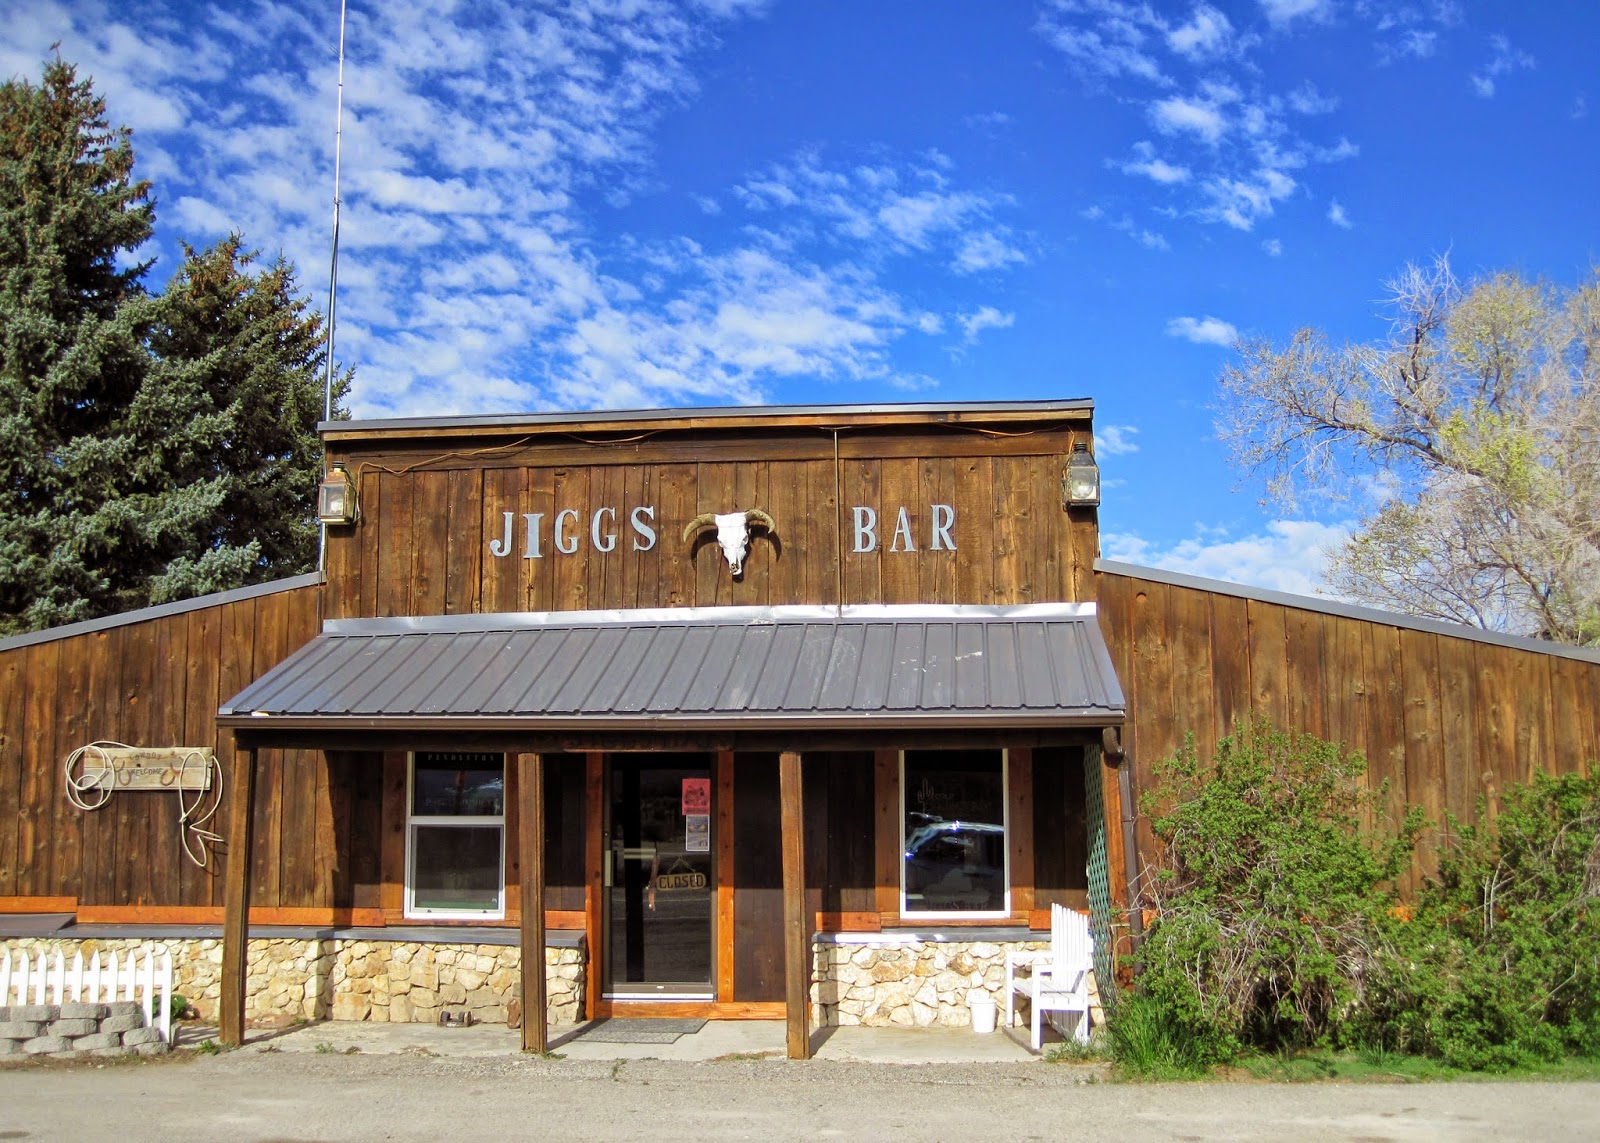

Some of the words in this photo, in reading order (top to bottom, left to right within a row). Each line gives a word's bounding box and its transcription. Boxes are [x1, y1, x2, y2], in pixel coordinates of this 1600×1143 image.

[489, 505, 657, 559] JIGGS
[851, 503, 958, 554] BAR
[659, 874, 704, 889] CLOSED
